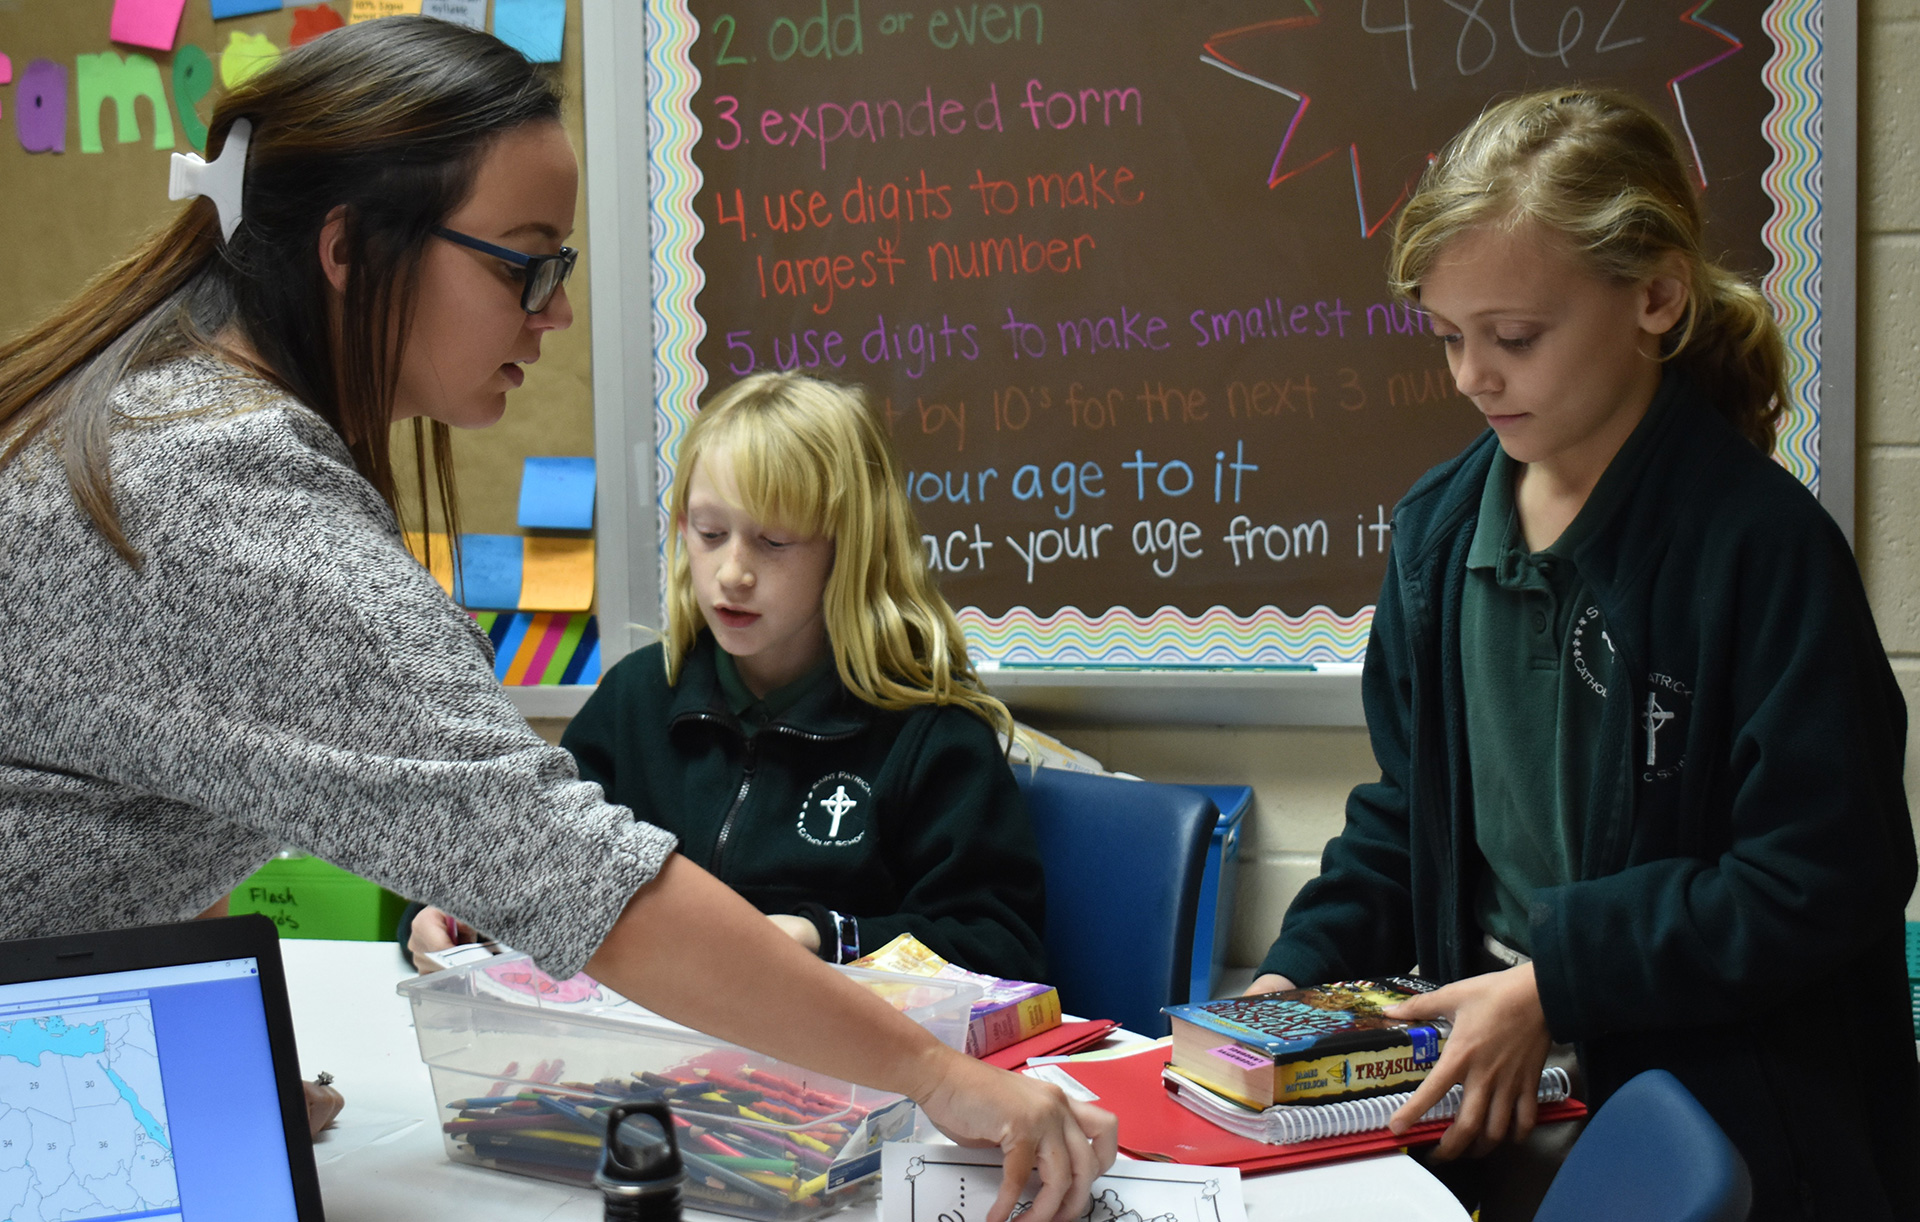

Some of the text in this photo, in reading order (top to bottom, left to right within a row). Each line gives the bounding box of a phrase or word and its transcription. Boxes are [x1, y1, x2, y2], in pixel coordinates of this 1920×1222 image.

[768, 0, 863, 61] odd
[879, 12, 914, 35] or
[928, 1, 1043, 49] even
[760, 82, 1004, 170] expanded
[1020, 79, 1142, 131] form
[764, 190, 832, 234] use
[842, 168, 952, 255] digits
[970, 169, 1018, 216] to
[1027, 163, 1144, 209] make
[757, 233, 1096, 314] largest number
[774, 329, 846, 370] use
[861, 314, 979, 379] digits
[1001, 307, 1046, 359] to
[1057, 305, 1171, 355] make
[1190, 298, 1351, 347] smallest
[917, 396, 965, 452] by
[1066, 382, 1124, 430] for
[1136, 379, 1209, 425] the
[1226, 374, 1318, 419] next
[1339, 368, 1367, 411] 3
[1011, 461, 1106, 520] age
[1121, 449, 1194, 501] to
[1214, 439, 1259, 503] it
[1006, 523, 1113, 584] your
[1132, 518, 1203, 578] age
[1223, 515, 1328, 567] from
[1357, 504, 1391, 557] it
[249, 887, 298, 906] Flash
[1285, 1078, 1328, 1093] PATTERSON
[1295, 1069, 1318, 1081] JAMES
